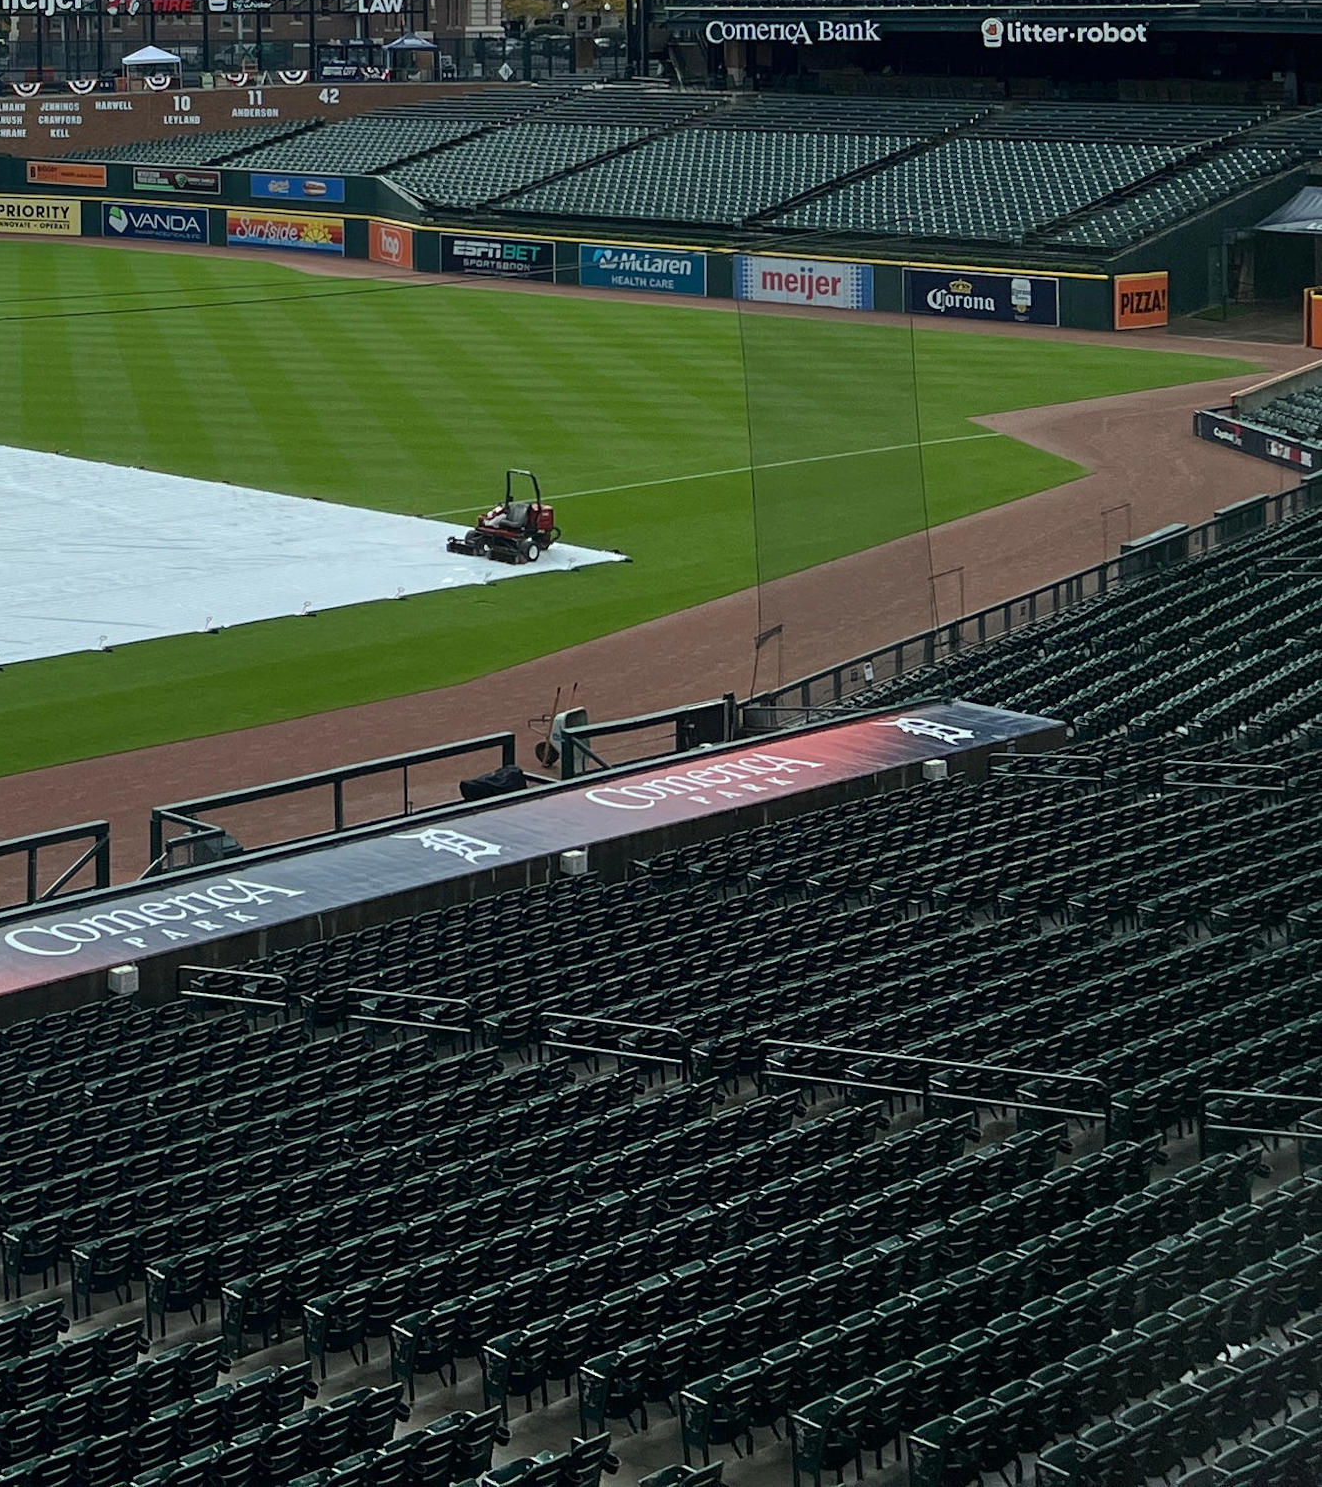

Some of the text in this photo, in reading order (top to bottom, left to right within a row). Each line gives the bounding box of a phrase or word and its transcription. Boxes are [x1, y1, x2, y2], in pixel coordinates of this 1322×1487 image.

[817, 20, 881, 43] Bank
[173, 96, 190, 111] 10
[248, 90, 263, 105] 11
[319, 89, 340, 104] 42
[95, 101, 132, 111] HARWELL
[232, 108, 278, 117] ANDERSON
[38, 116, 82, 125] CRAWFORD
[164, 116, 201, 125] LEYLAND
[50, 129, 70, 138] KELL
[129, 212, 201, 232] VANDA
[236, 216, 298, 241] Surfside
[503, 243, 541, 262] BET
[463, 258, 531, 271] SPORTSBOOK
[619, 252, 692, 275] McLaren
[611, 275, 674, 290] HEALTH CARE
[761, 266, 841, 300] meijer
[927, 287, 995, 312] Corona
[1120, 289, 1167, 316] PIZZA!
[688, 776, 794, 805] PARK
[123, 911, 258, 949] PARK
